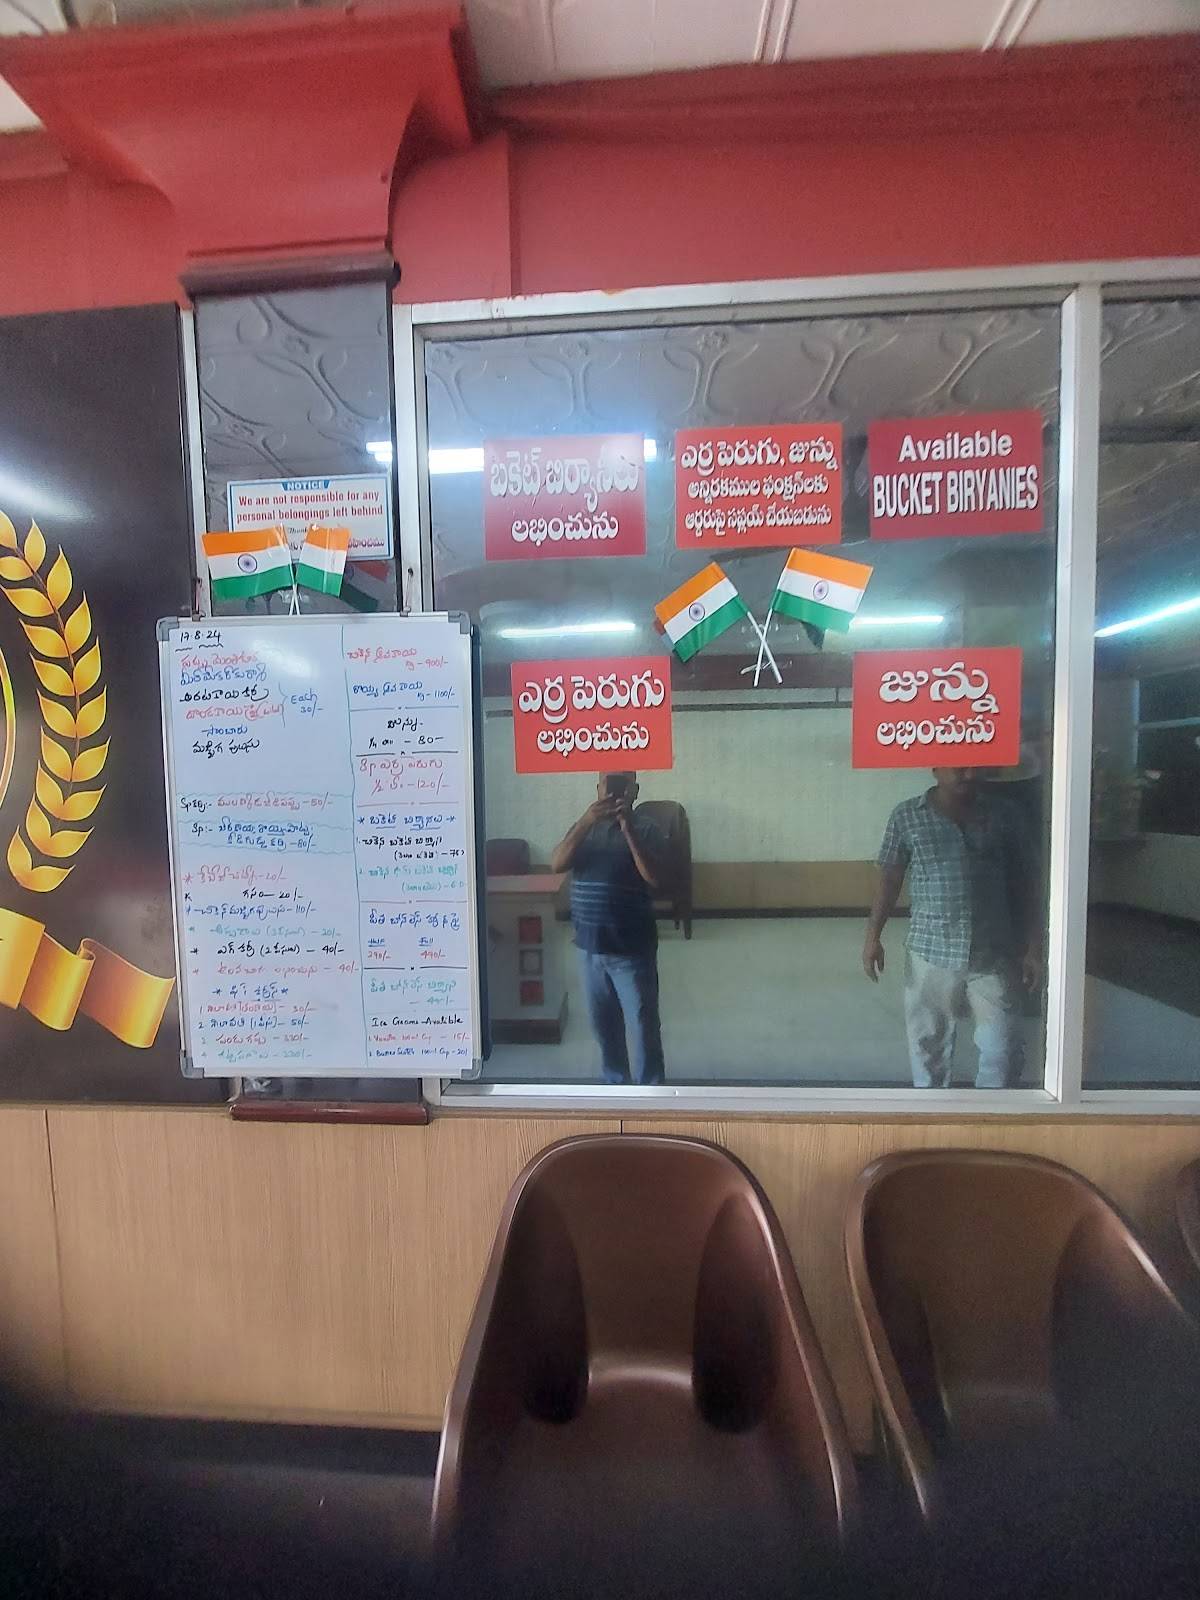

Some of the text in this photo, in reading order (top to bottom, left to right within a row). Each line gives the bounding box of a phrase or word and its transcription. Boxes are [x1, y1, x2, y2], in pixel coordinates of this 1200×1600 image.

[681, 440, 715, 476] ఎర్ర
[789, 436, 838, 471] జున్ను
[898, 429, 1013, 463] Available
[287, 481, 323, 491] NOTICE
[490, 447, 541, 498] బకెట్
[238, 491, 379, 506] We are not responsible for any
[873, 465, 1039, 518] BUCKET BIRYANIES
[236, 505, 383, 523] personal belongings left behind
[511, 512, 619, 546] లభించును
[518, 669, 665, 724] ఎర్ర పెరుగు
[879, 661, 1000, 714] జున్ను
[537, 720, 650, 758] లభించును
[876, 714, 996, 751] లభించును
